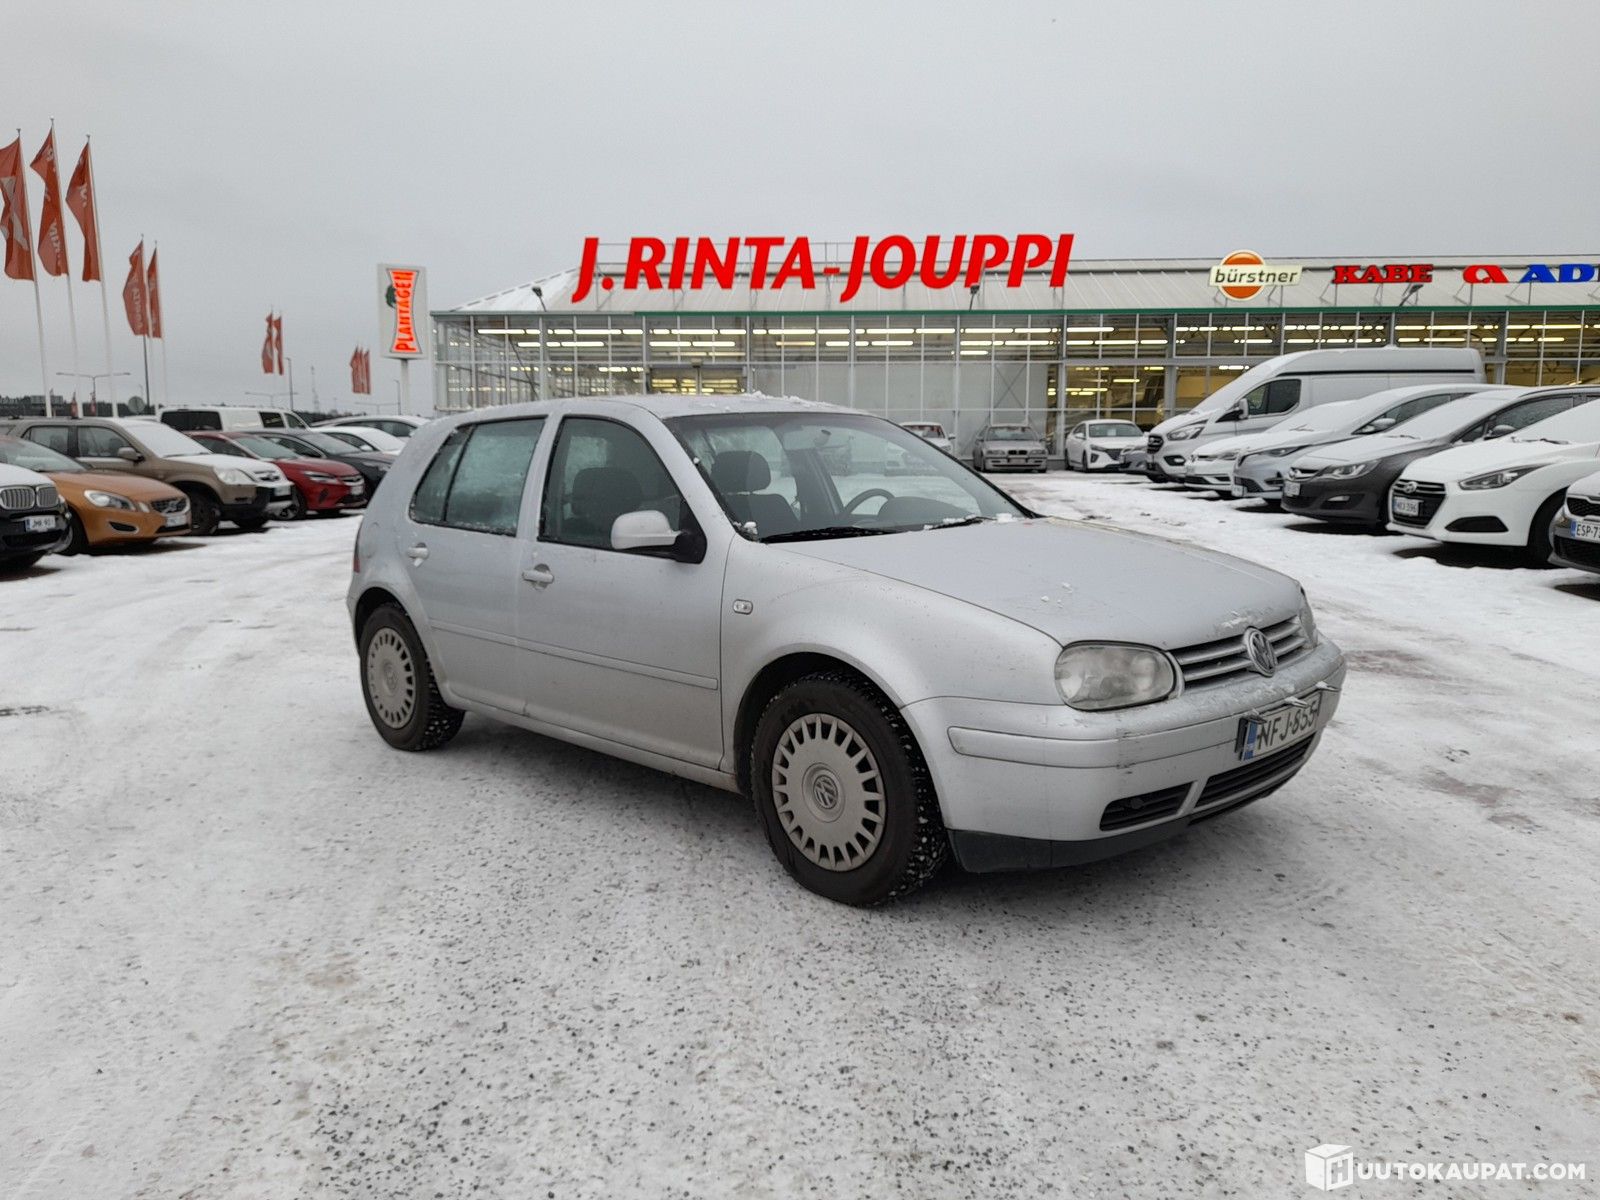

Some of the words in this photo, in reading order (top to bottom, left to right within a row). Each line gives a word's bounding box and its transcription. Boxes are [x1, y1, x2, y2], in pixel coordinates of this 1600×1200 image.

[1215, 268, 1297, 283] bürstner
[1331, 264, 1433, 284] KABE
[392, 271, 417, 351] PLANTAGEN
[1576, 523, 1600, 538] ESP-7
